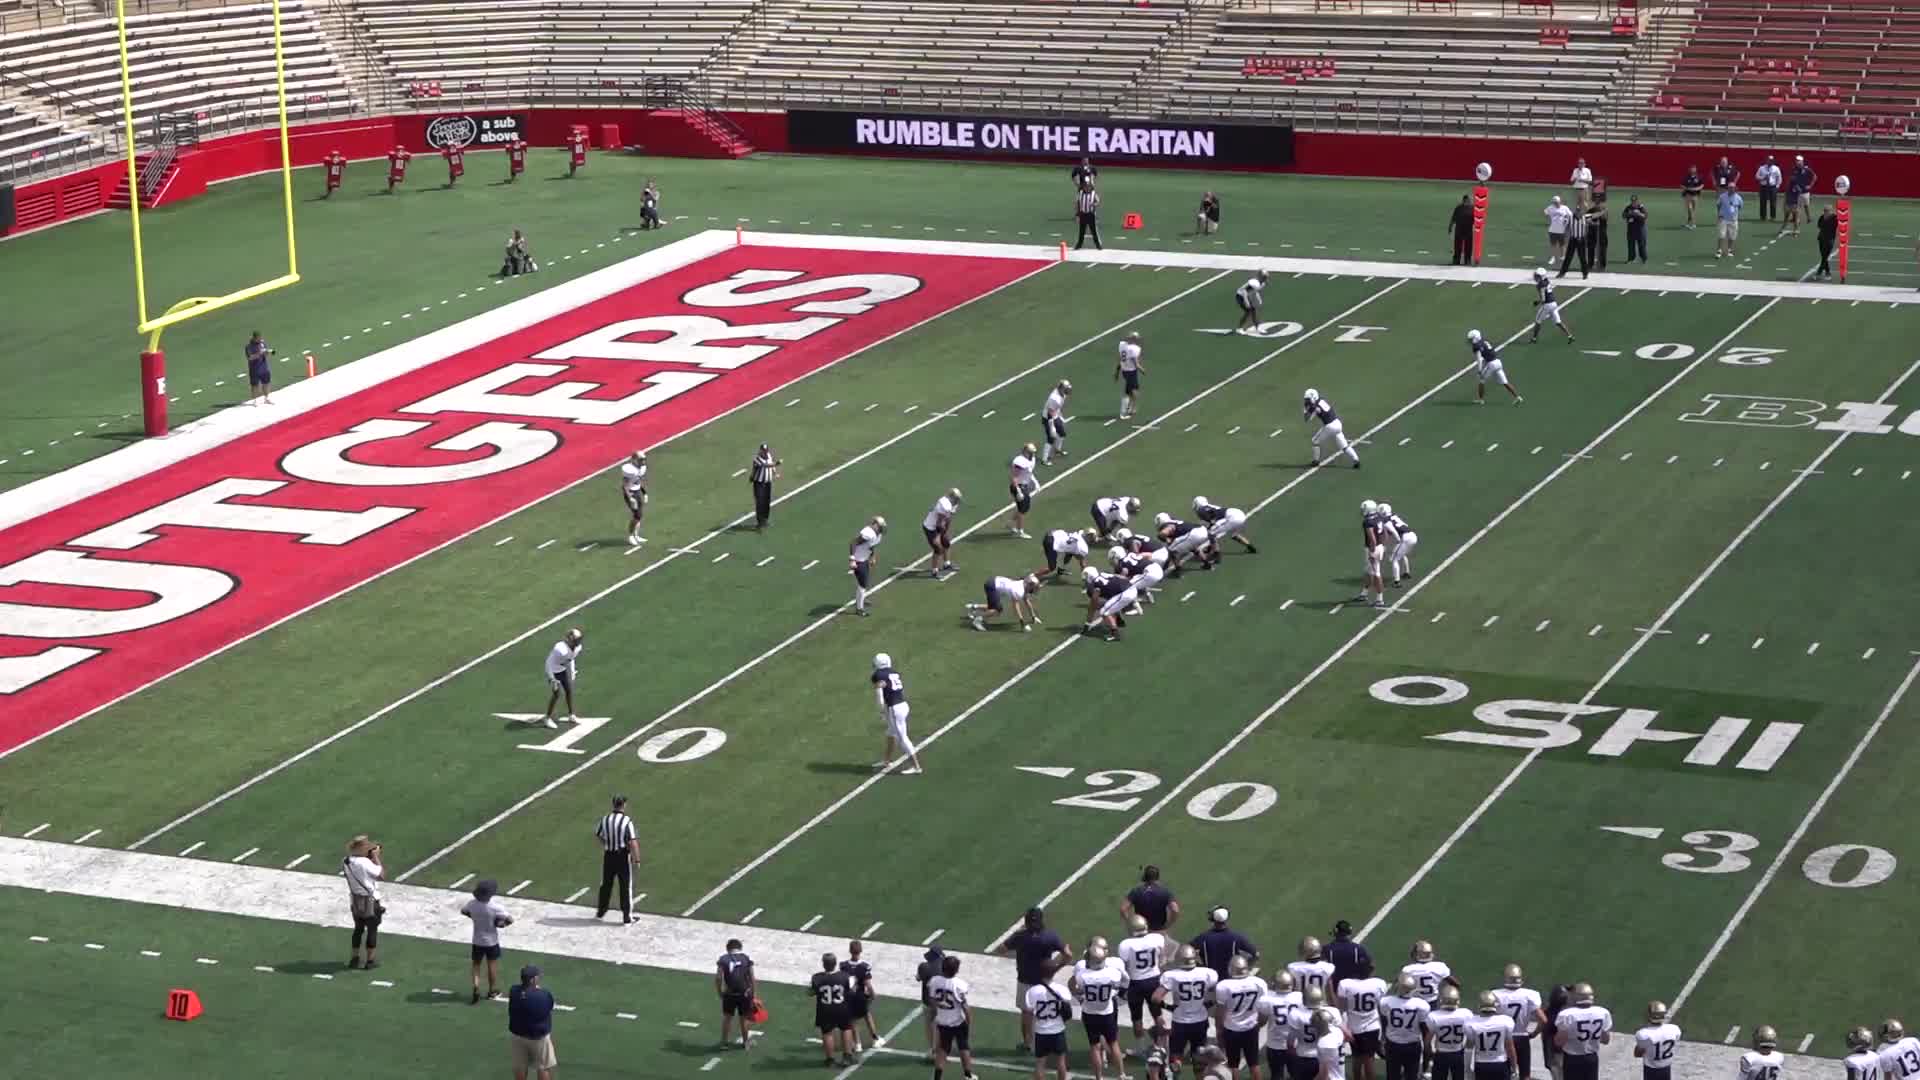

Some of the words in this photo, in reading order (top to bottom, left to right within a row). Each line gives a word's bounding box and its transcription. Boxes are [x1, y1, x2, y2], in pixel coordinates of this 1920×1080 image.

[433, 119, 470, 135] Jersey
[482, 119, 489, 129] a
[494, 116, 516, 129] sub
[481, 131, 519, 142] above
[857, 118, 975, 148] RUMBLE
[981, 123, 1020, 150] ON
[1027, 125, 1081, 152] THE
[1088, 127, 1215, 157] RARITAN
[1127, 215, 1136, 226] G
[0, 268, 924, 695] UTGERS
[1421, 699, 1806, 771] SHI
[1135, 947, 1156, 969] 51
[819, 984, 845, 1005] 33
[1085, 983, 1112, 1002] 60
[1178, 980, 1205, 1001] 53
[1419, 976, 1433, 995] 5
[171, 993, 188, 1017] 10
[1035, 1000, 1060, 1020] 23
[1231, 991, 1258, 1012] 77
[1353, 993, 1375, 1012] 16
[1390, 1007, 1417, 1029] 67
[1507, 1003, 1522, 1023] 7
[1439, 1024, 1464, 1044] 25
[1576, 1018, 1603, 1041] 52
[1479, 1031, 1501, 1051] 17
[1653, 1039, 1676, 1061] 12
[1896, 1049, 1920, 1077] 13
